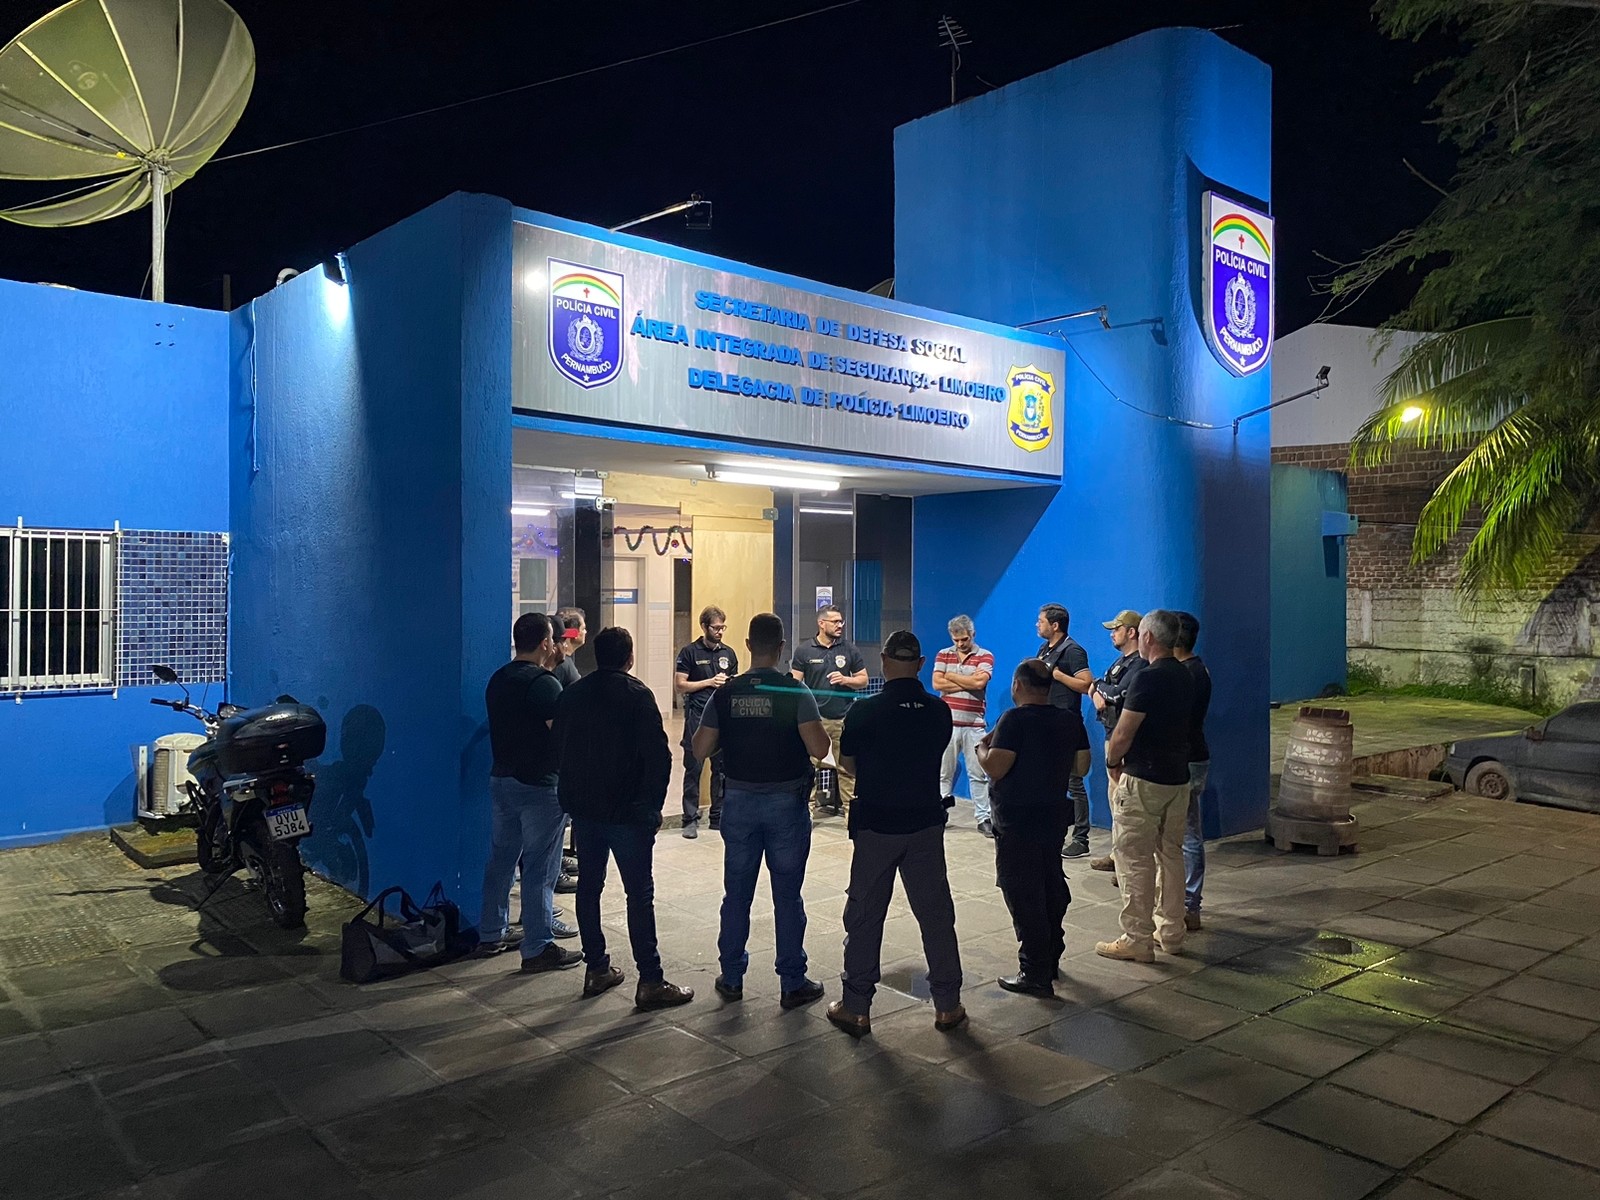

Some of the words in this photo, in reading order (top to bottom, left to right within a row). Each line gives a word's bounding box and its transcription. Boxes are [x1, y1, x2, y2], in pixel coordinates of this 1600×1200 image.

[1215, 248, 1246, 272] POLÍCIA
[1247, 260, 1267, 279] CIVIL
[556, 299, 592, 314] POLÍCIA
[594, 306, 616, 319] CIVIL
[630, 309, 689, 346] ÁREA
[695, 329, 804, 367] INTEGRADA
[808, 352, 832, 372] DE
[694, 290, 812, 332] SECRETARIA
[816, 317, 841, 338] DE
[847, 323, 908, 352] DEFESA
[911, 338, 967, 363] SOCIAL
[1219, 326, 1263, 356] PERNAMBUCO
[561, 353, 612, 374] PERNAMBUCO
[688, 368, 797, 404] DELEGACIA
[801, 386, 825, 407] DE
[740, 707, 764, 716] CIVIL
[274, 820, 305, 836] 5J84
